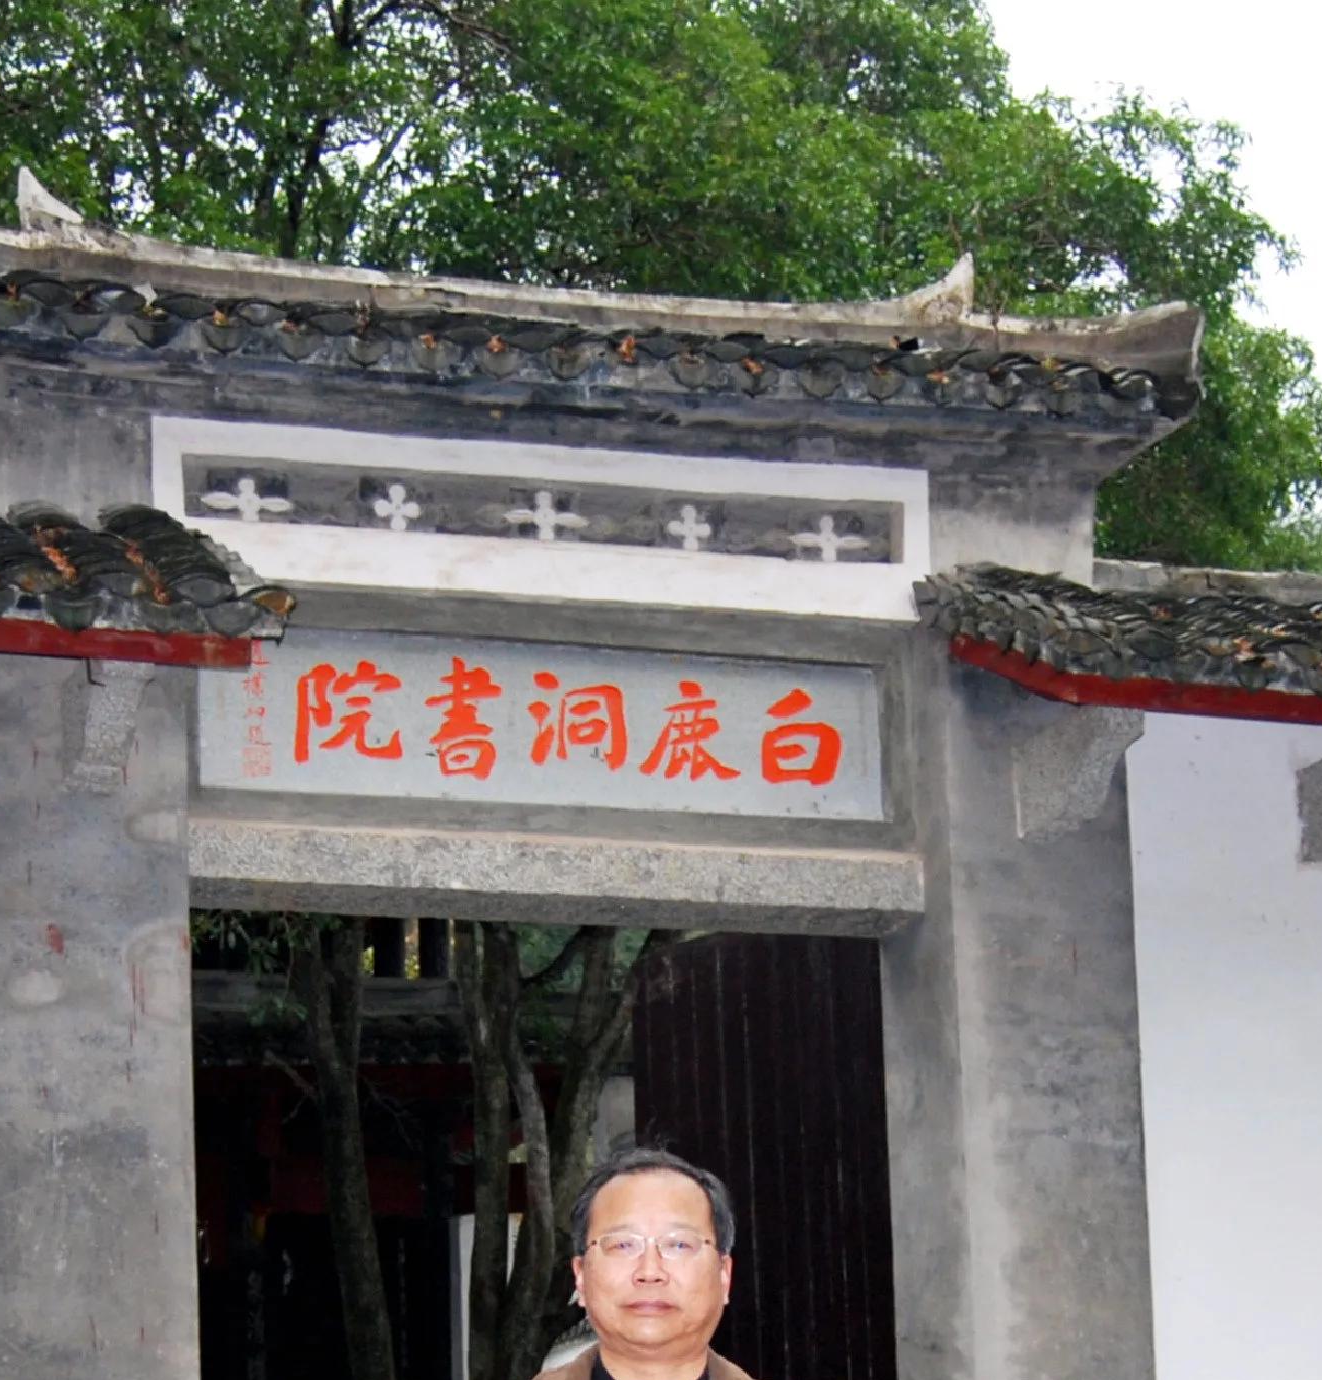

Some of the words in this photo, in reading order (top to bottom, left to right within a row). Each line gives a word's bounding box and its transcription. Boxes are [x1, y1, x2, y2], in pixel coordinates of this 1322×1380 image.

[294, 656, 842, 785] 白鹿洞書院
